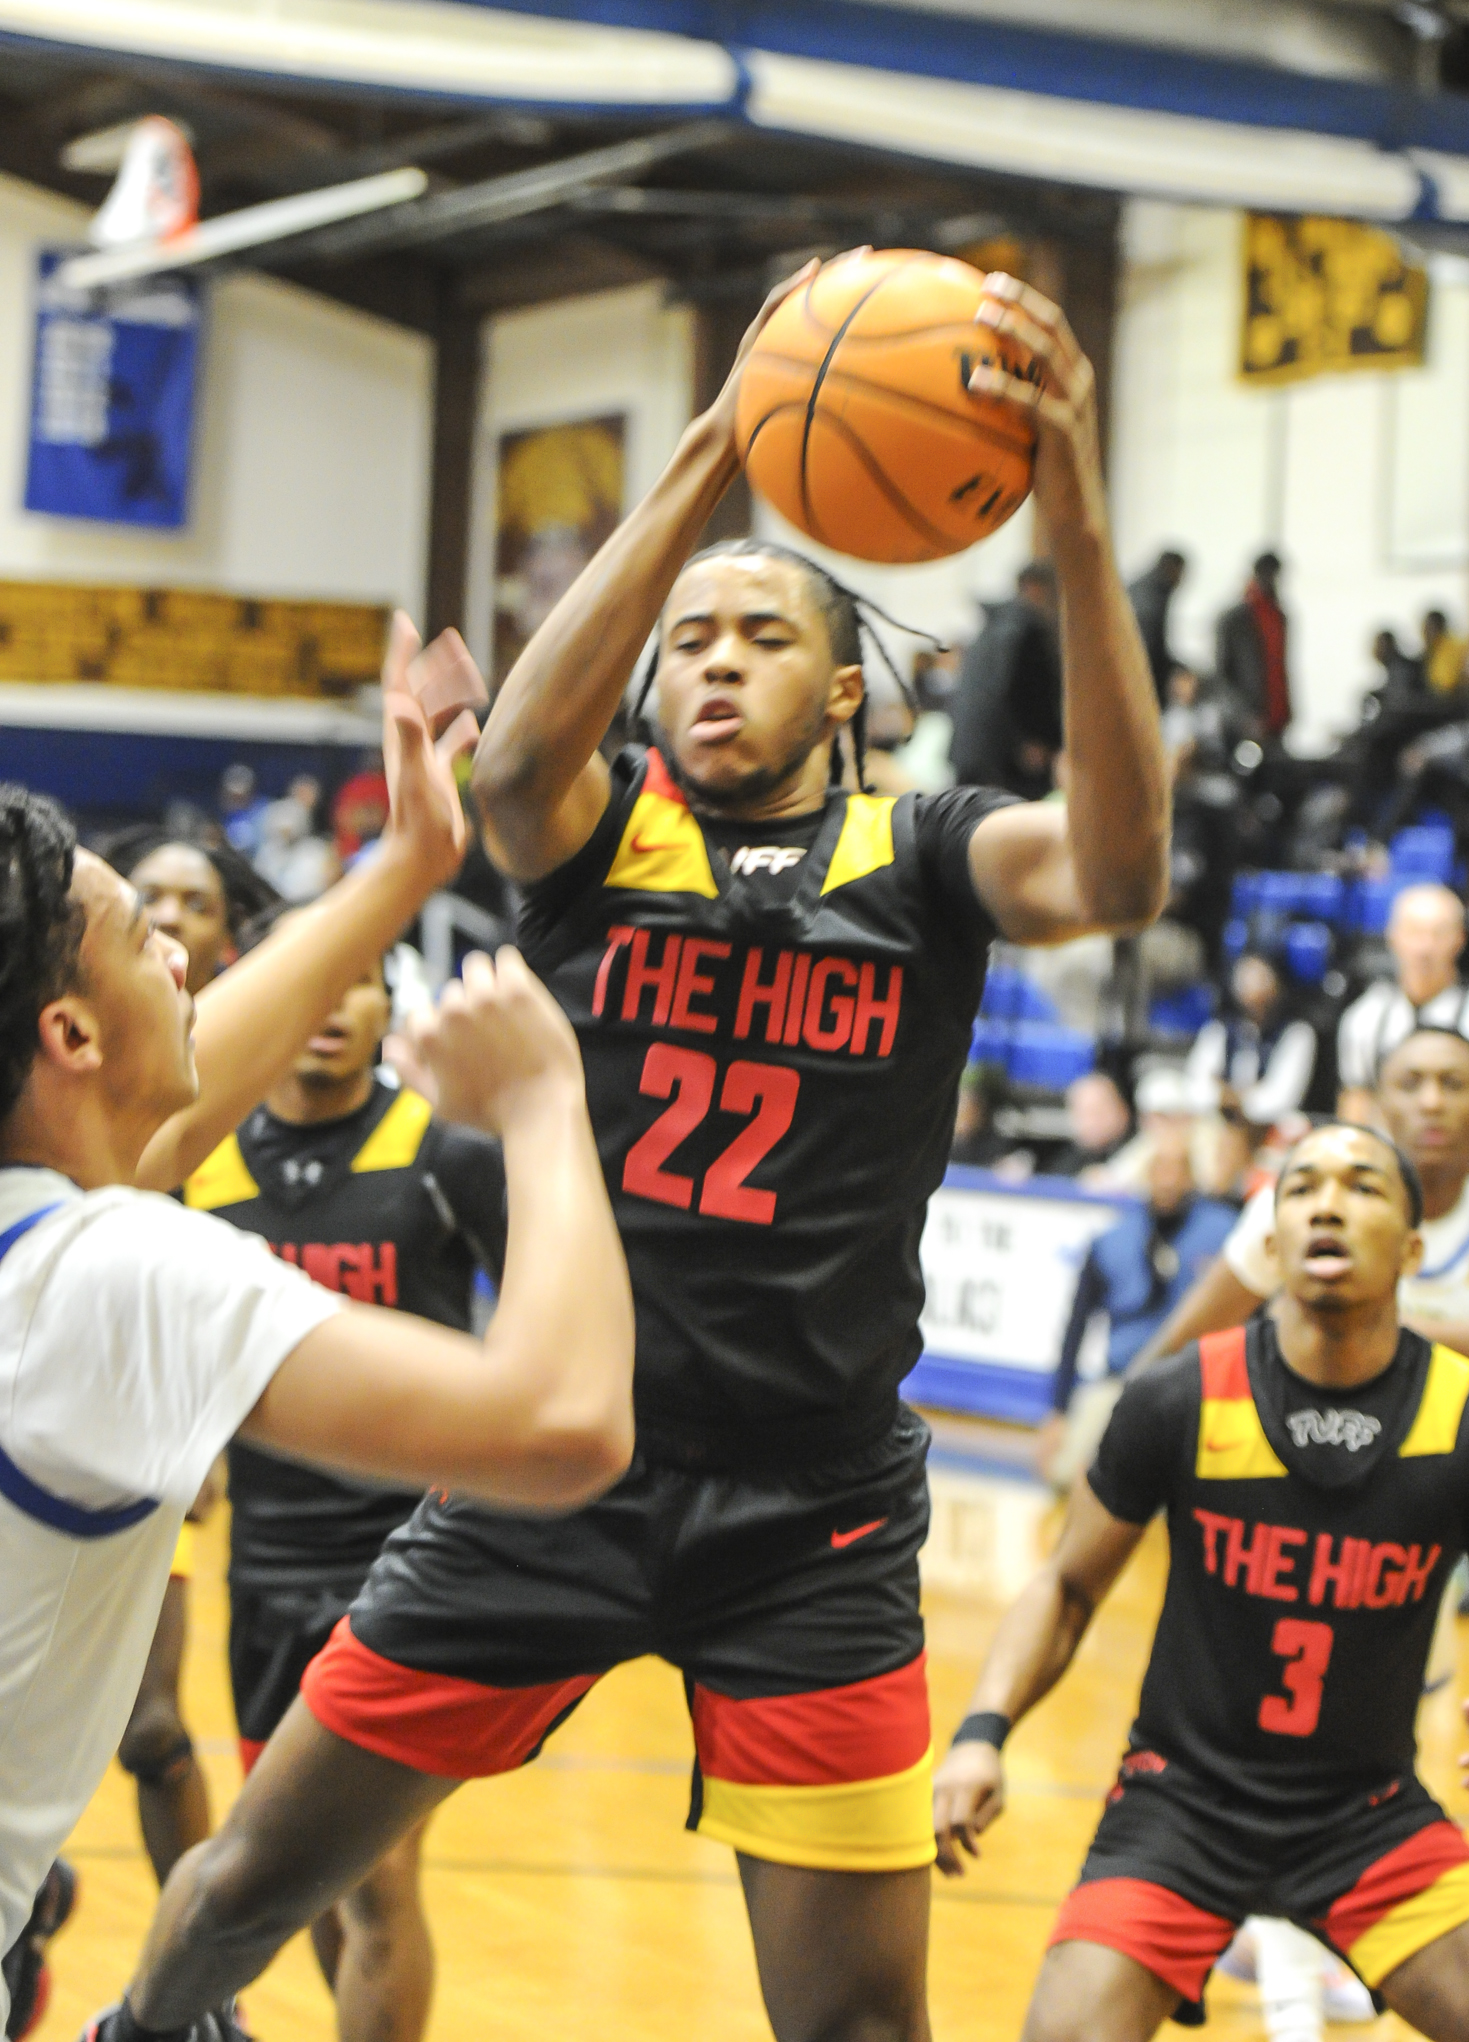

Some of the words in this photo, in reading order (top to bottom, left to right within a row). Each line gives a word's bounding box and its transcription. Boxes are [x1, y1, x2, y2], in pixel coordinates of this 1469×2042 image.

[592, 925, 732, 1034] THE
[733, 947, 904, 1058] HIGH
[622, 1042, 800, 1225] 22
[1193, 1508, 1307, 1602] THE
[1308, 1533, 1441, 1609] HIGH
[1258, 1618, 1334, 1737] 3
